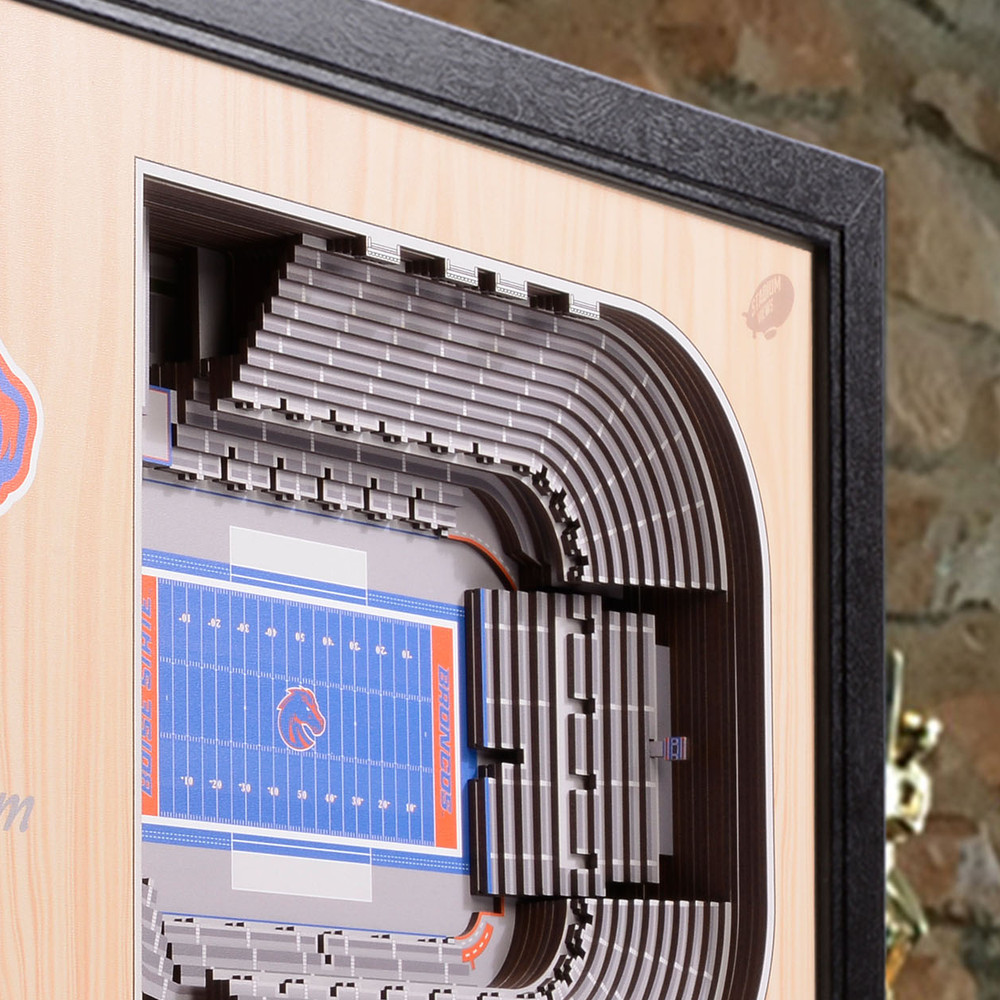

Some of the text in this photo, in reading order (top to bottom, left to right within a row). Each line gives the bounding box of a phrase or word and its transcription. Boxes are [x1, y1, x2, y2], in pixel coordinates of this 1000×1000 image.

[438, 664, 452, 814] BRONCOS
[184, 776, 194, 786] 10
[211, 779, 222, 789] 20
[297, 789, 307, 800] 50
